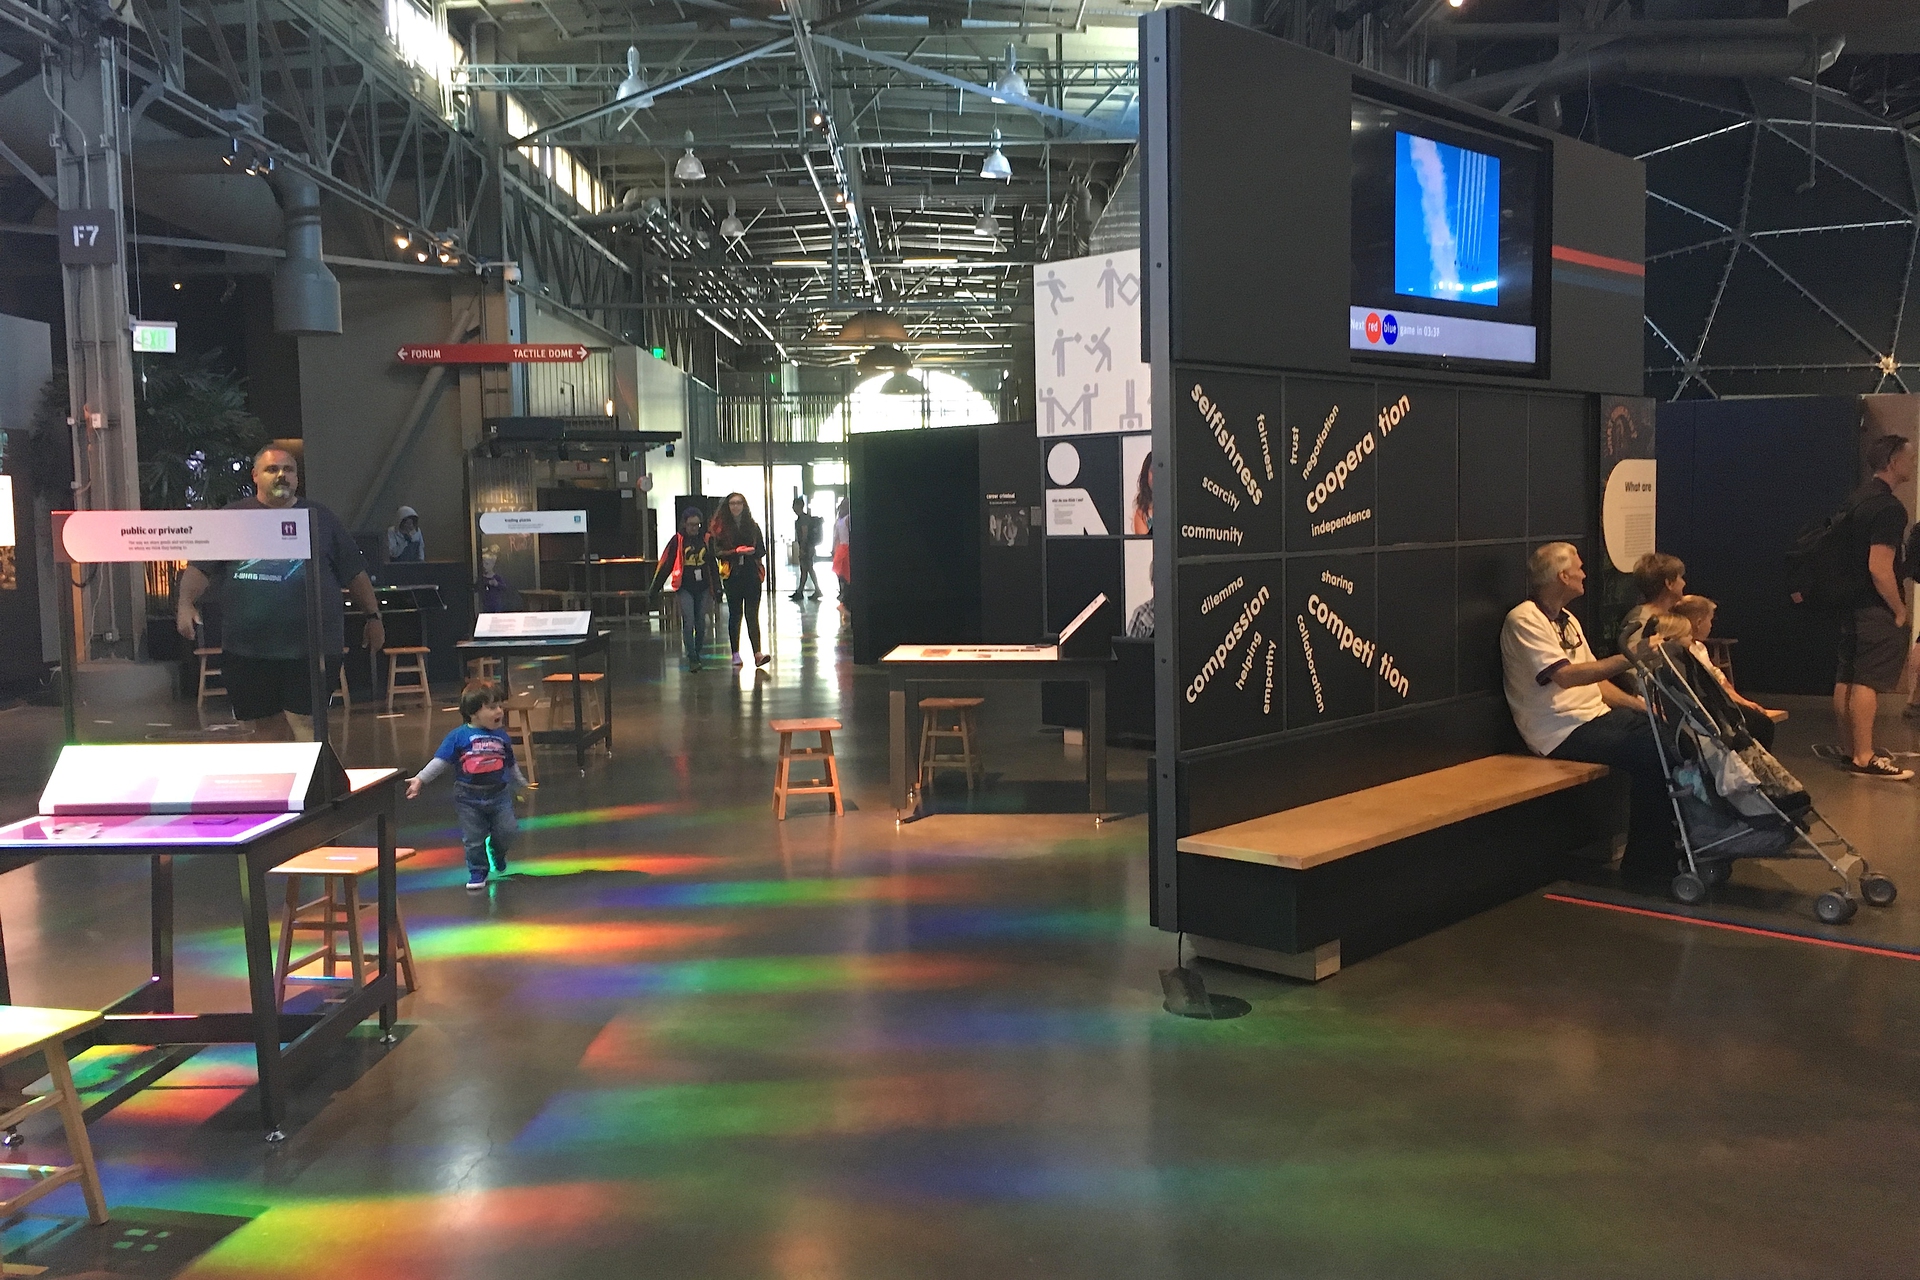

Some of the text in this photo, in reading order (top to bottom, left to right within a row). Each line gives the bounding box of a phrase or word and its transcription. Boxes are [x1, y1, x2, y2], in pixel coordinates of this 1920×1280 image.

[73, 225, 99, 247] F7
[141, 329, 168, 350] EXIT
[1368, 321, 1378, 332] red
[1383, 322, 1396, 334] blue
[1400, 326, 1414, 336] game
[1416, 326, 1422, 335] in
[411, 349, 441, 359] FORUM
[513, 348, 573, 358] TACTILE DOME
[1190, 383, 1263, 506] selfishness
[1256, 413, 1274, 481] fairness
[1289, 426, 1299, 465] trust
[1302, 404, 1339, 481] negotiation
[1202, 476, 1240, 512] scarcity
[1625, 481, 1652, 492] What are
[121, 526, 146, 536] public
[158, 526, 193, 536] private?
[1181, 525, 1244, 547] community
[1311, 508, 1371, 537] independence
[1201, 576, 1244, 615] dilemma
[1321, 570, 1353, 595] sharing
[1186, 585, 1270, 704] compassion
[1235, 630, 1262, 691] helping
[1263, 639, 1277, 715] empathy
[1297, 614, 1325, 714] collaboration
